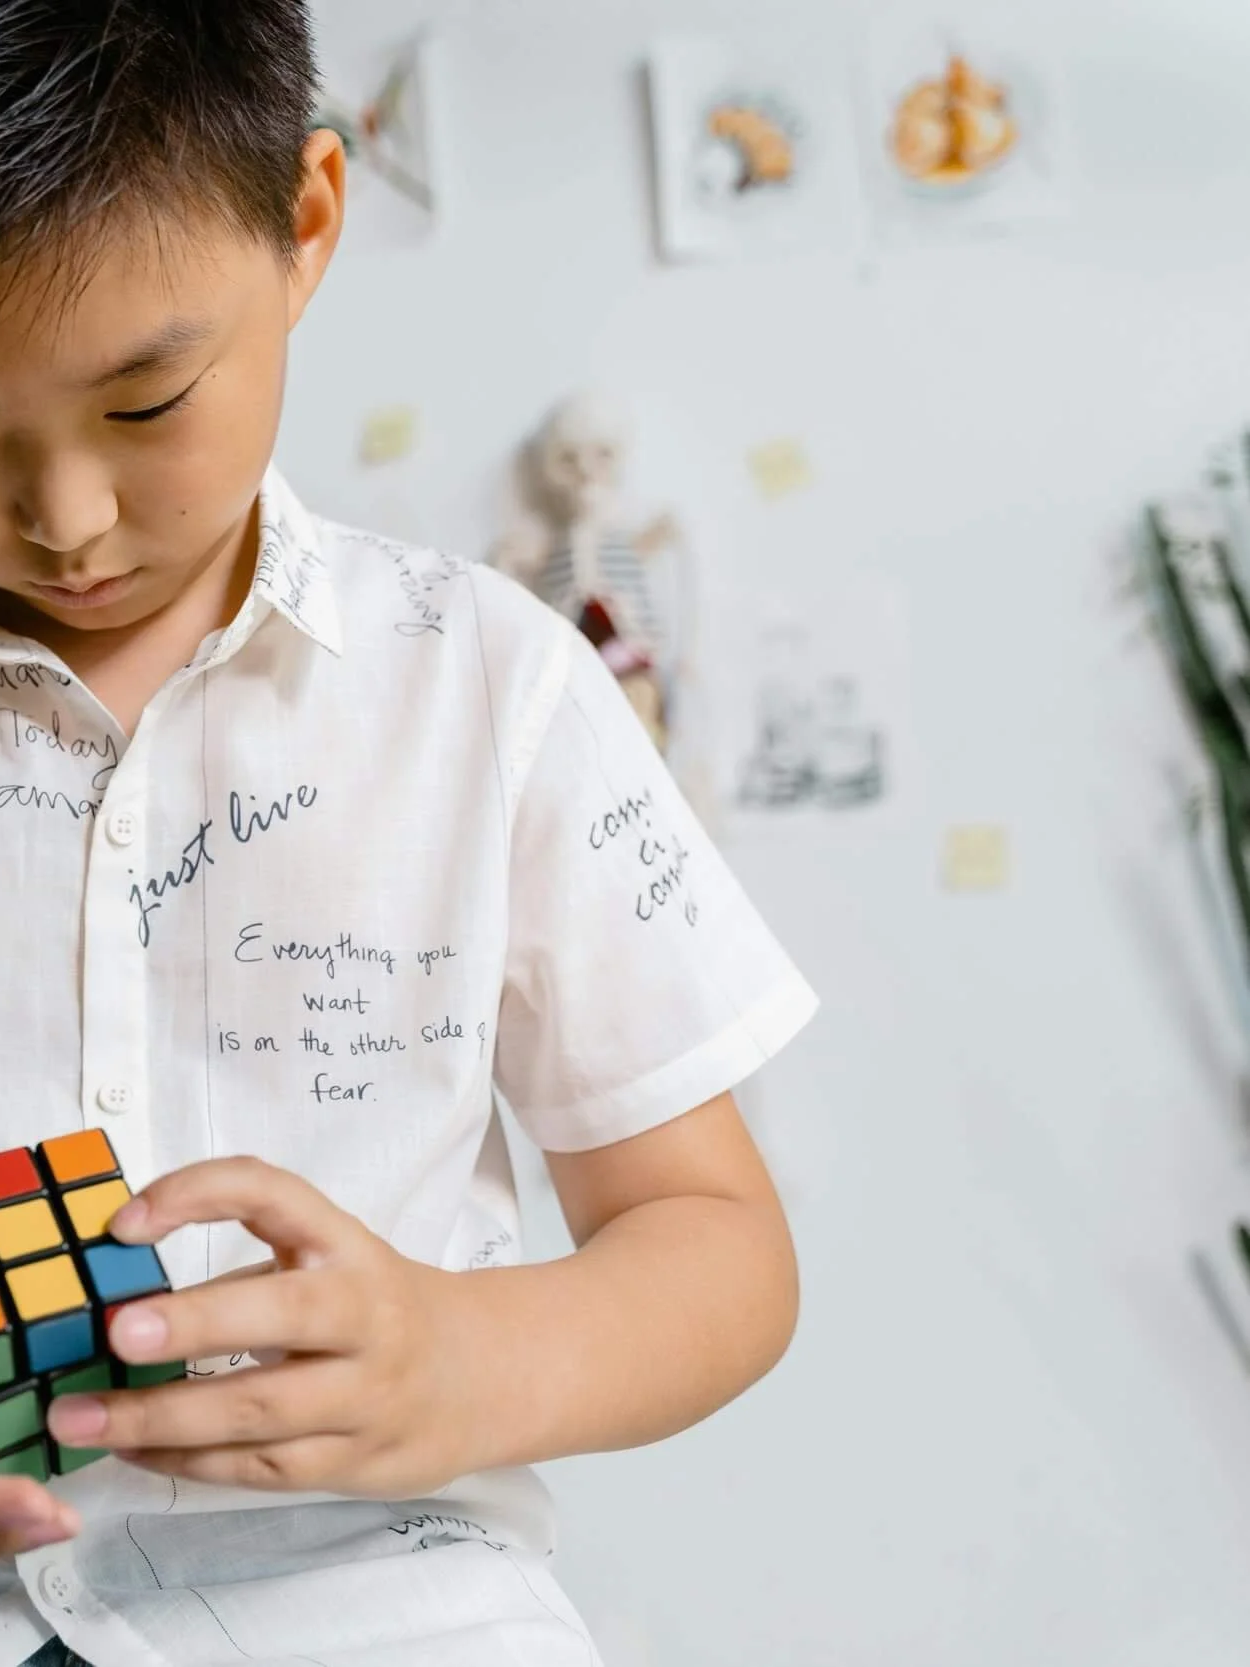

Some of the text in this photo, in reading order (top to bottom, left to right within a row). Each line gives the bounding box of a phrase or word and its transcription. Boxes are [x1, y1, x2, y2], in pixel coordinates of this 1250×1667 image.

[128, 785, 317, 948] just live
[234, 923, 457, 979] Everything you
[254, 1036, 279, 1053] on
[298, 1028, 334, 1056] the
[350, 1033, 406, 1056] other
[310, 1073, 377, 1103] fear.
